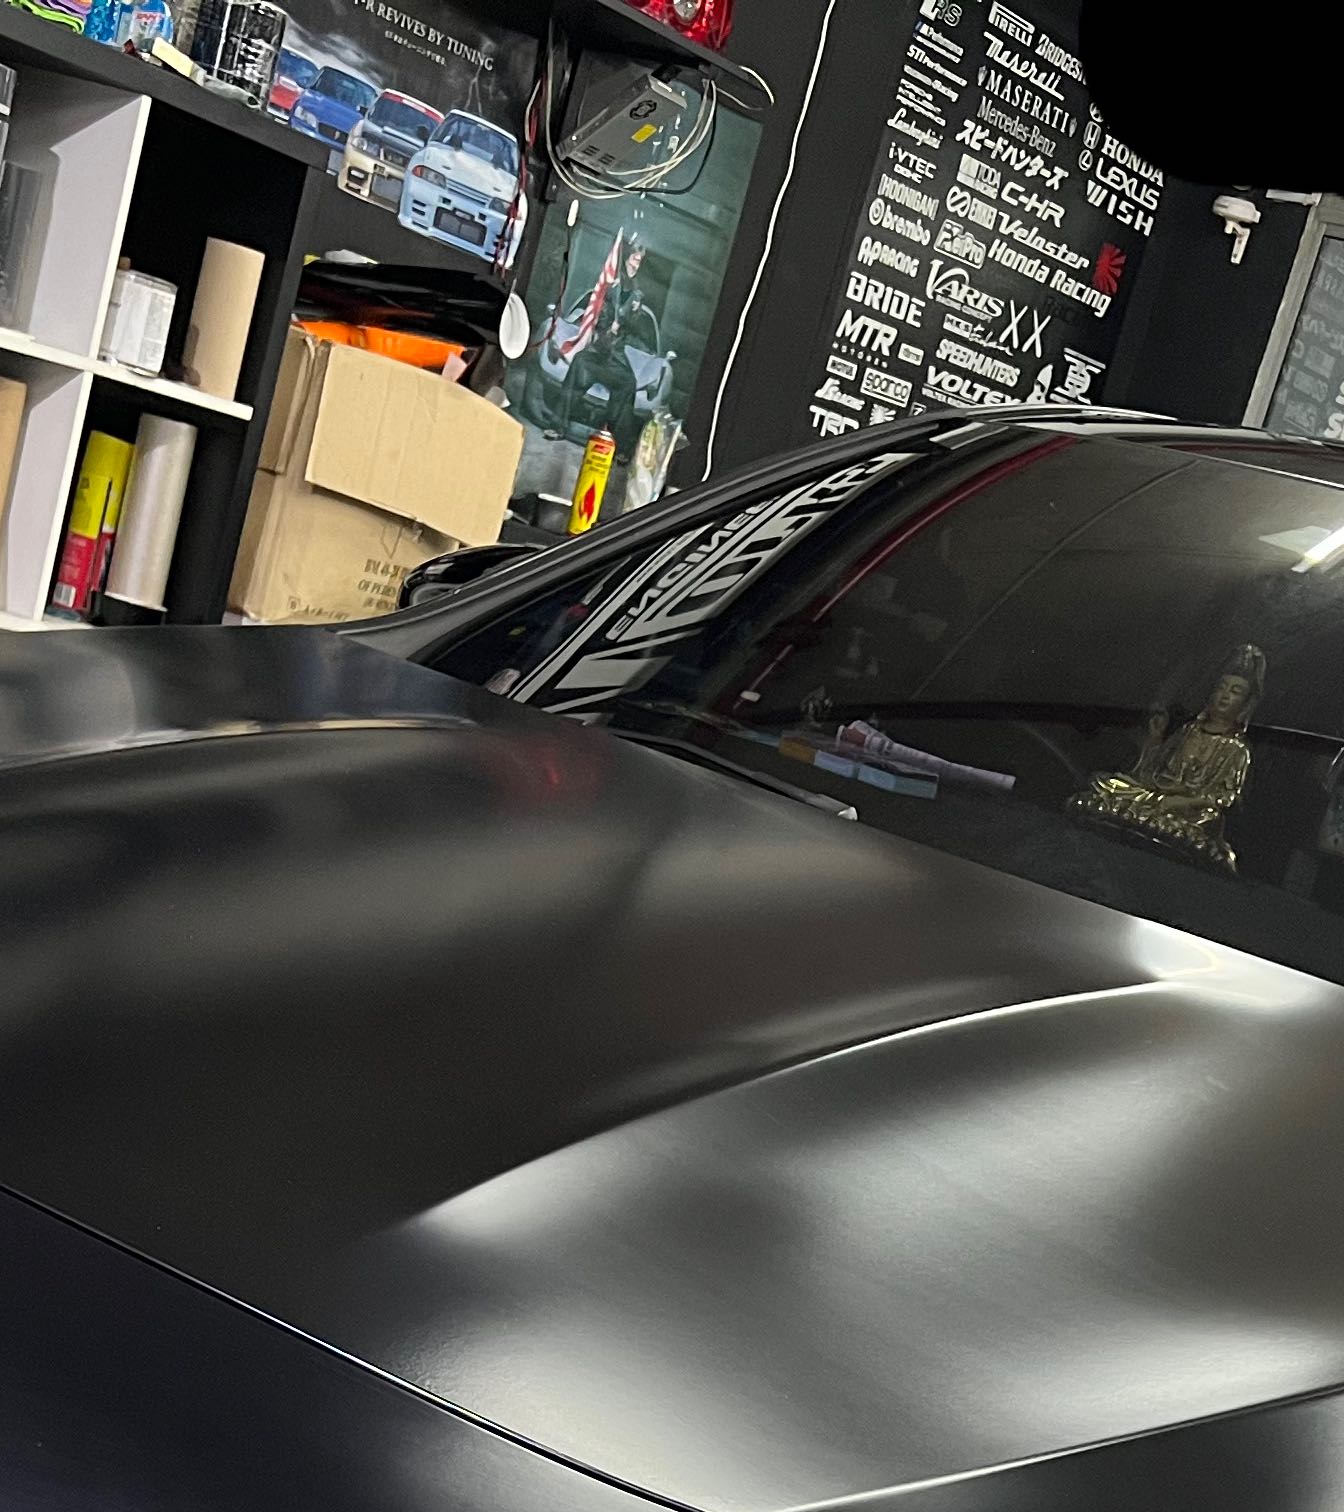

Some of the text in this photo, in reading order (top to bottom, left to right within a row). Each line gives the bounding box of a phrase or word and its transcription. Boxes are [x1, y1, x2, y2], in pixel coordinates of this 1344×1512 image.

[377, 4, 426, 37] REVIVES
[427, 27, 445, 46] BY
[446, 36, 494, 71] TUNING
[988, 1, 1035, 47] PIRELLI
[1035, 33, 1087, 85] BRIDGES
[977, 95, 1057, 159] Mercedes-Benz
[985, 69, 1070, 134] MASERATI
[956, 119, 1069, 191] スピードハンターズ
[1095, 156, 1161, 212] LEXUS
[1101, 133, 1164, 188] HONDA
[881, 204, 931, 247] brembo
[1000, 181, 1067, 229] C-HR
[1086, 178, 1155, 238] WISH
[998, 210, 1091, 270] Veloster
[845, 270, 926, 329] BRIDE
[925, 258, 1006, 319] VARIS
[987, 238, 1051, 285] Honda
[1049, 267, 1113, 319] Racing
[834, 307, 899, 357] MTR
[935, 338, 1022, 389] SPEEDHUNTERS
